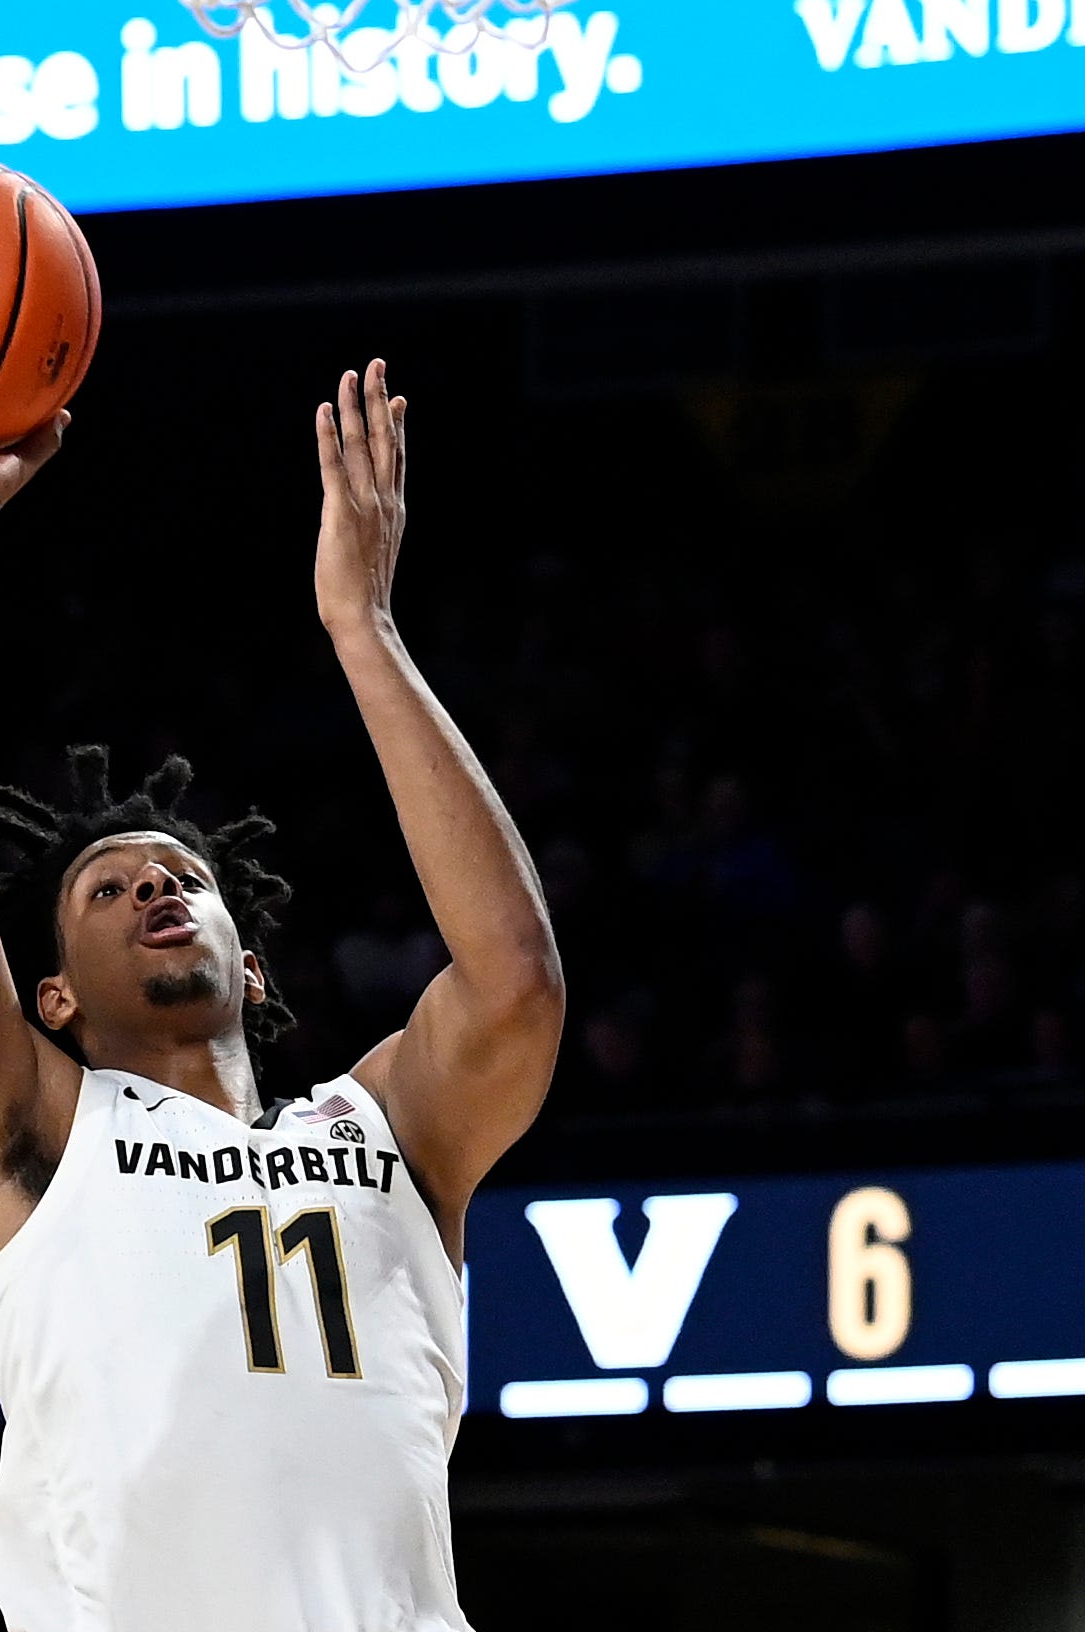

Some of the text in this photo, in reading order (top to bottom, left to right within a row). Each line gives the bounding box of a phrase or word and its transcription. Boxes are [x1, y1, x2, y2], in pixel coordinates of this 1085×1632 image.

[119, 16, 222, 132] in
[239, 5, 643, 124] history.
[115, 1138, 399, 1193] VANDERBILT
[204, 1205, 364, 1380] 11
[524, 1186, 913, 1370] V 6
